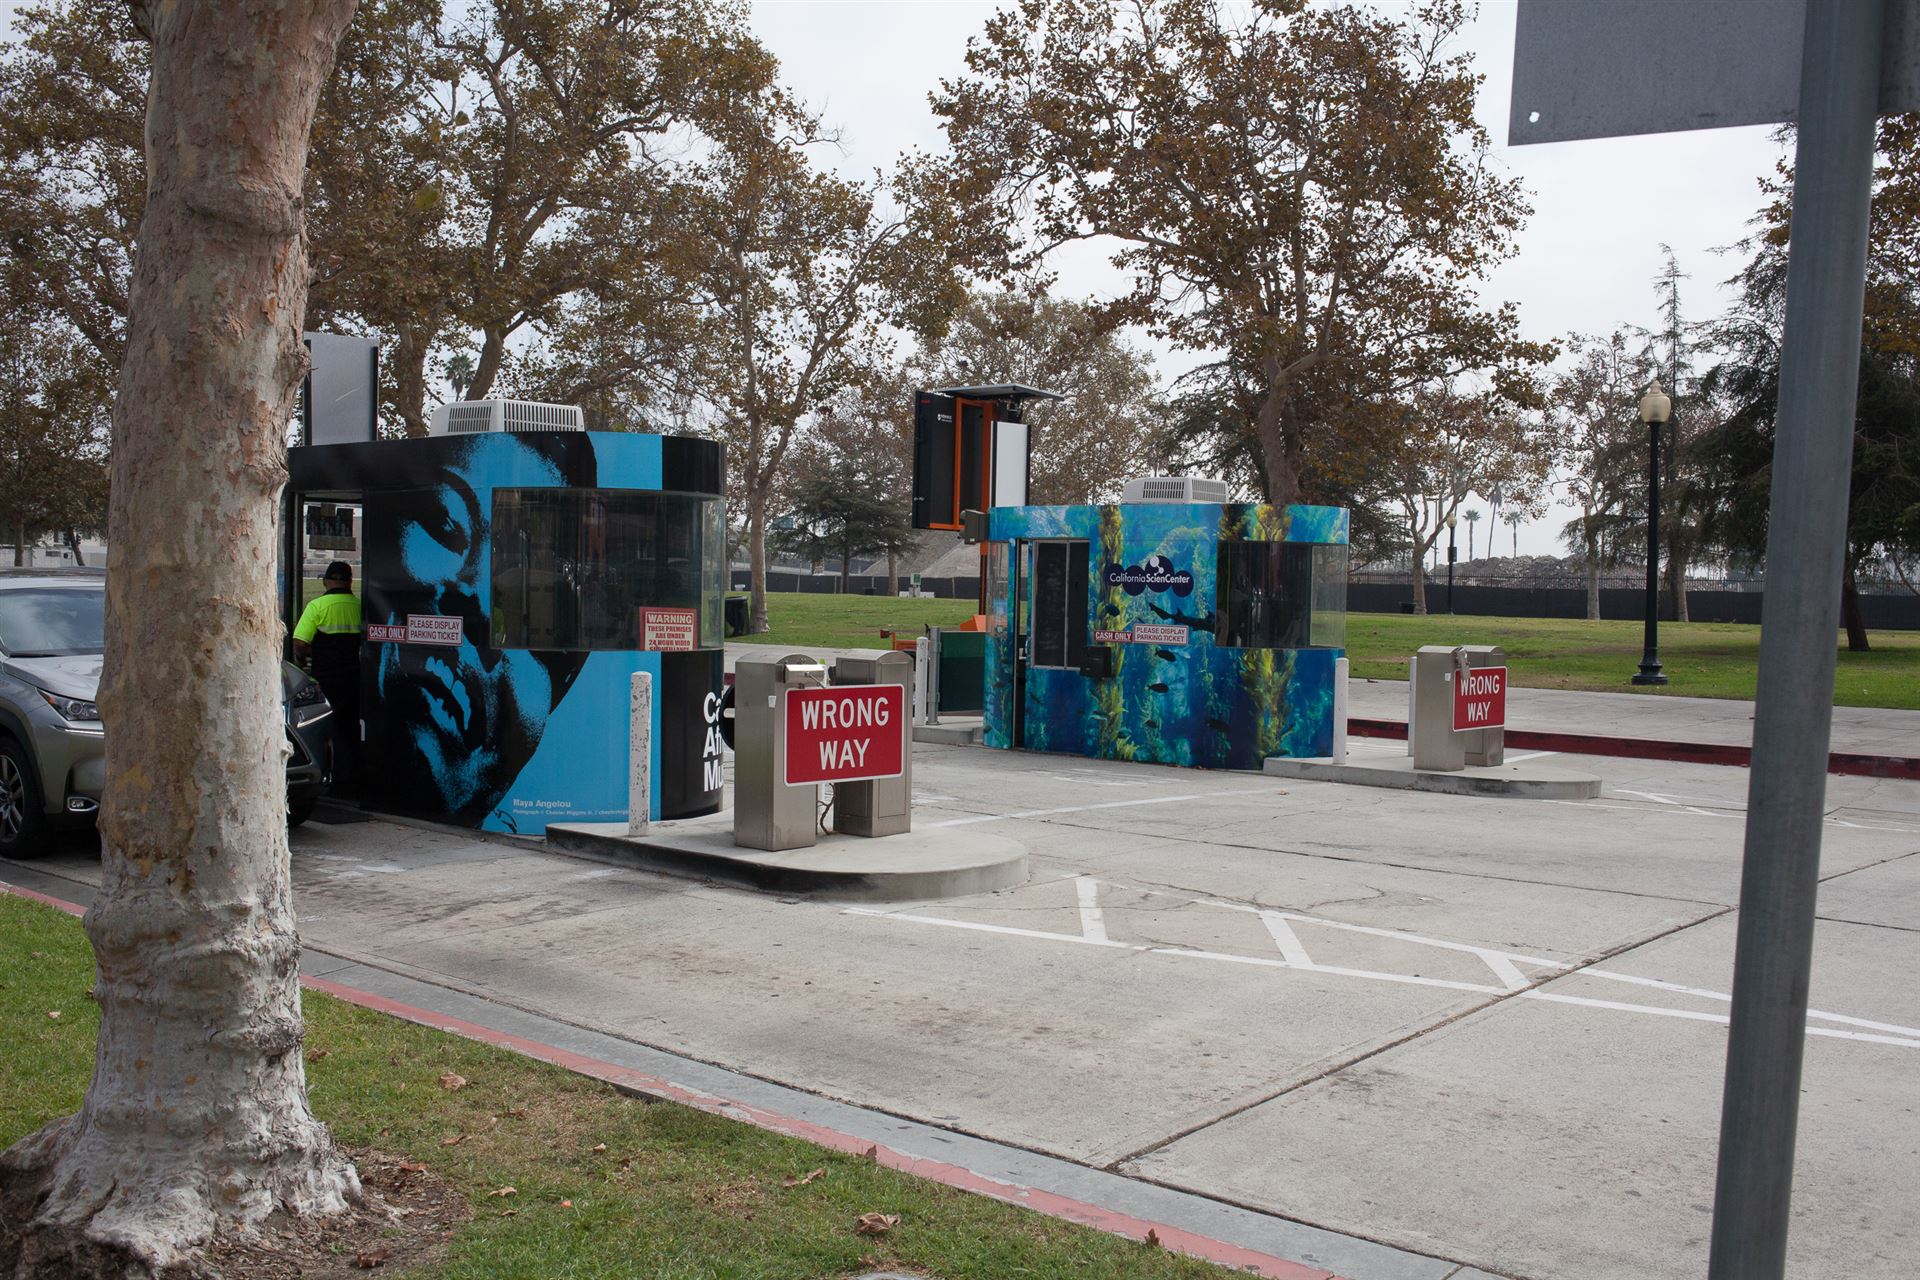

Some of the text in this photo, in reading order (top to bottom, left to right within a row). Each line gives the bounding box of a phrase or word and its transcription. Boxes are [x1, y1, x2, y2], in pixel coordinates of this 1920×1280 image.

[647, 613, 692, 624] WARNING
[410, 620, 460, 630] PLEASE DISPLAY
[1136, 626, 1185, 635] PLEASE DISPLAY
[369, 626, 406, 639] CASH ONLY
[410, 630, 459, 641] PARKING TICKET
[1095, 631, 1132, 641] CASH ONLY
[1460, 674, 1500, 697] WRONG
[801, 696, 889, 731] WRONG
[1467, 701, 1491, 722] WAY
[819, 738, 871, 771] WAY
[512, 798, 571, 809] Maya Angelou
